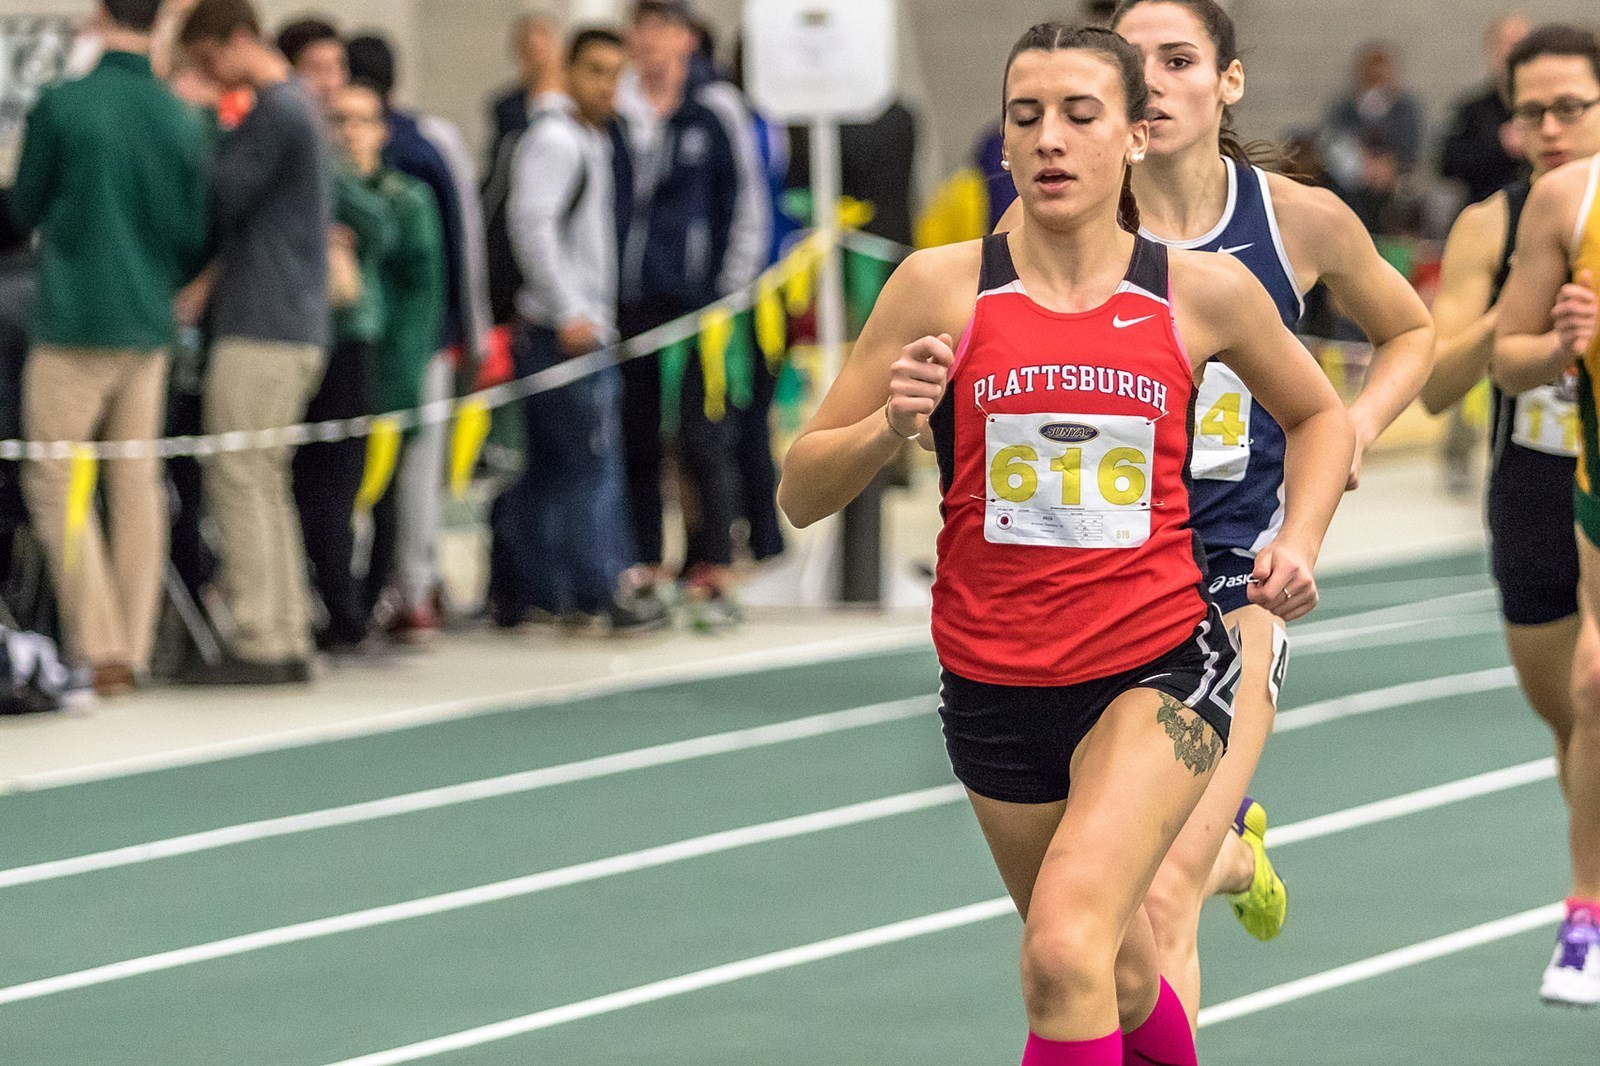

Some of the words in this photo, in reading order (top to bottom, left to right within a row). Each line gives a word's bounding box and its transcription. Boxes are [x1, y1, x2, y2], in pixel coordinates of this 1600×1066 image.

[973, 364, 1168, 414] PLATTSBURGH
[1045, 426, 1094, 439] SUNYAC
[1195, 392, 1246, 446] 4
[989, 444, 1147, 506] 616
